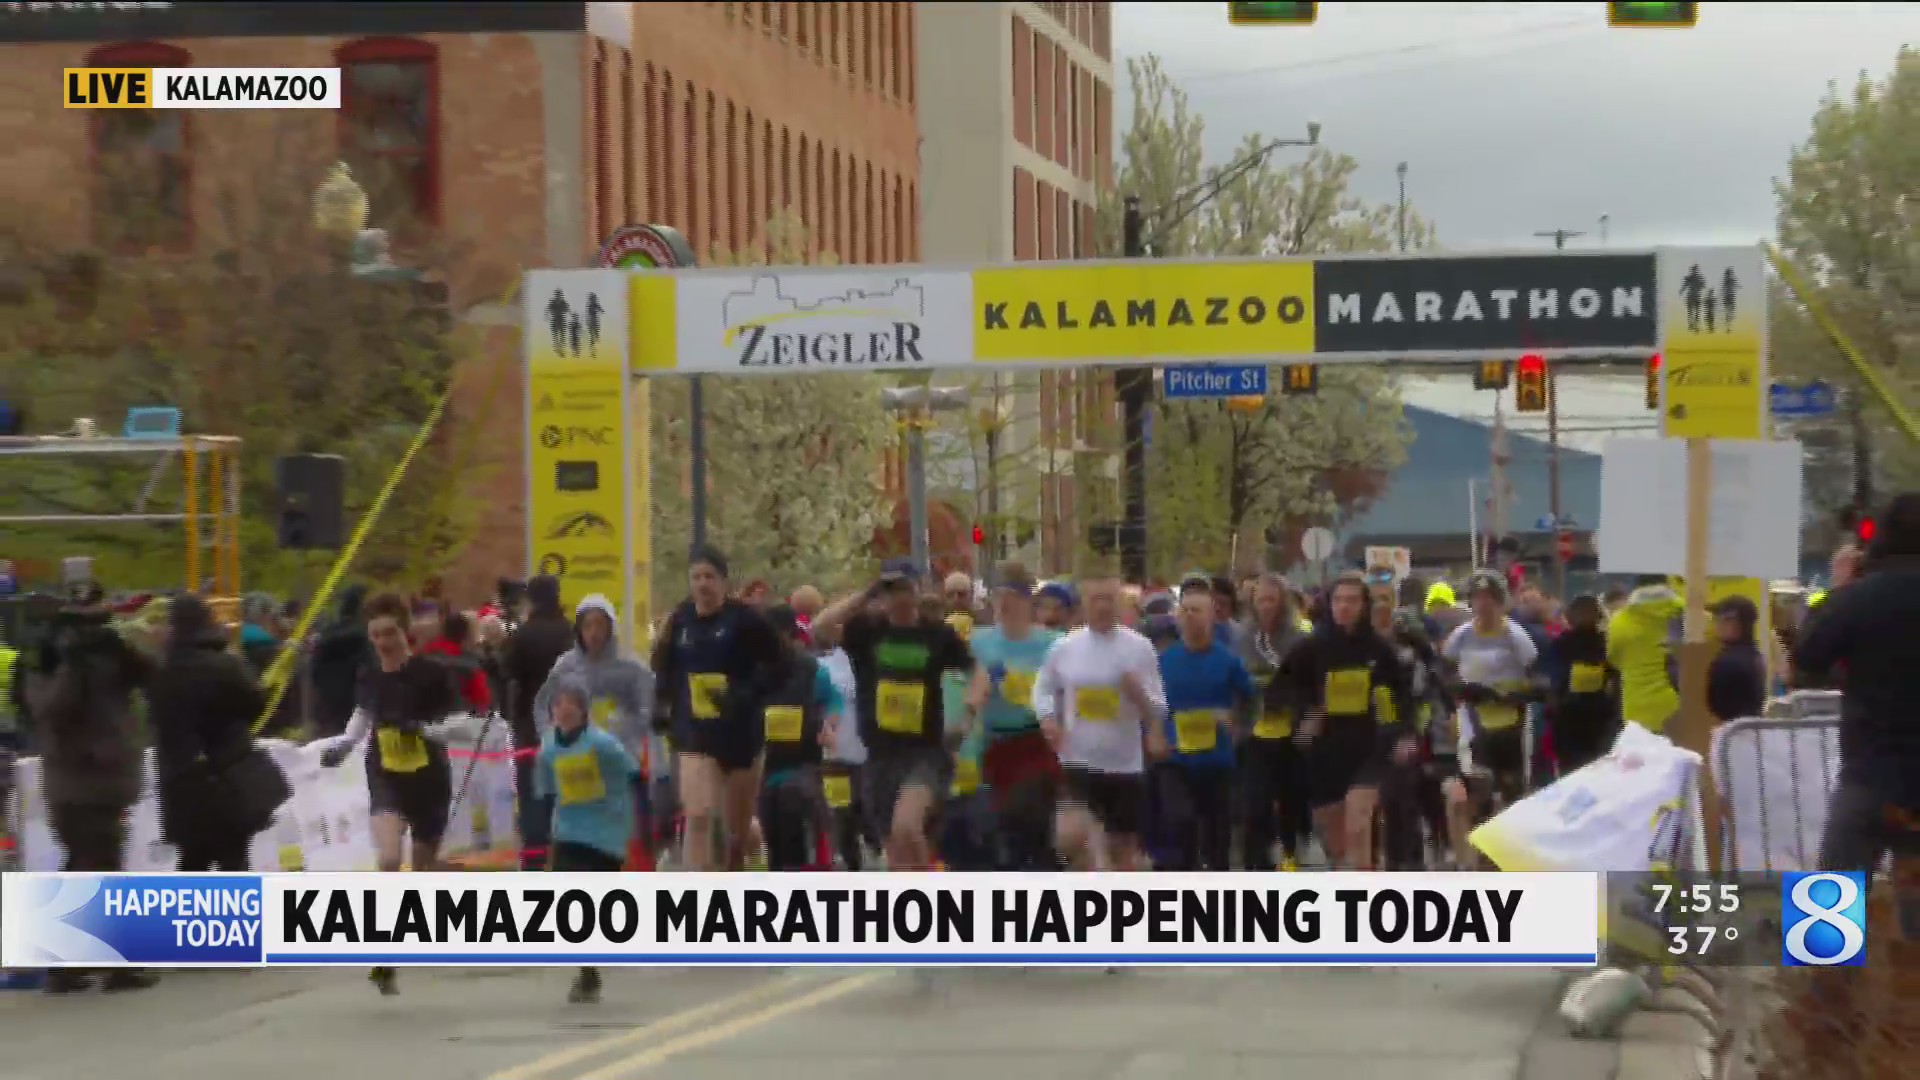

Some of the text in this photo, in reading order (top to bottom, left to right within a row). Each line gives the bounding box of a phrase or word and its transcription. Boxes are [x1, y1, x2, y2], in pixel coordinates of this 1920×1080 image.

[984, 286, 1643, 330] KALAMAZOO MARATHON
[1170, 368, 1259, 391] Pitcher St
